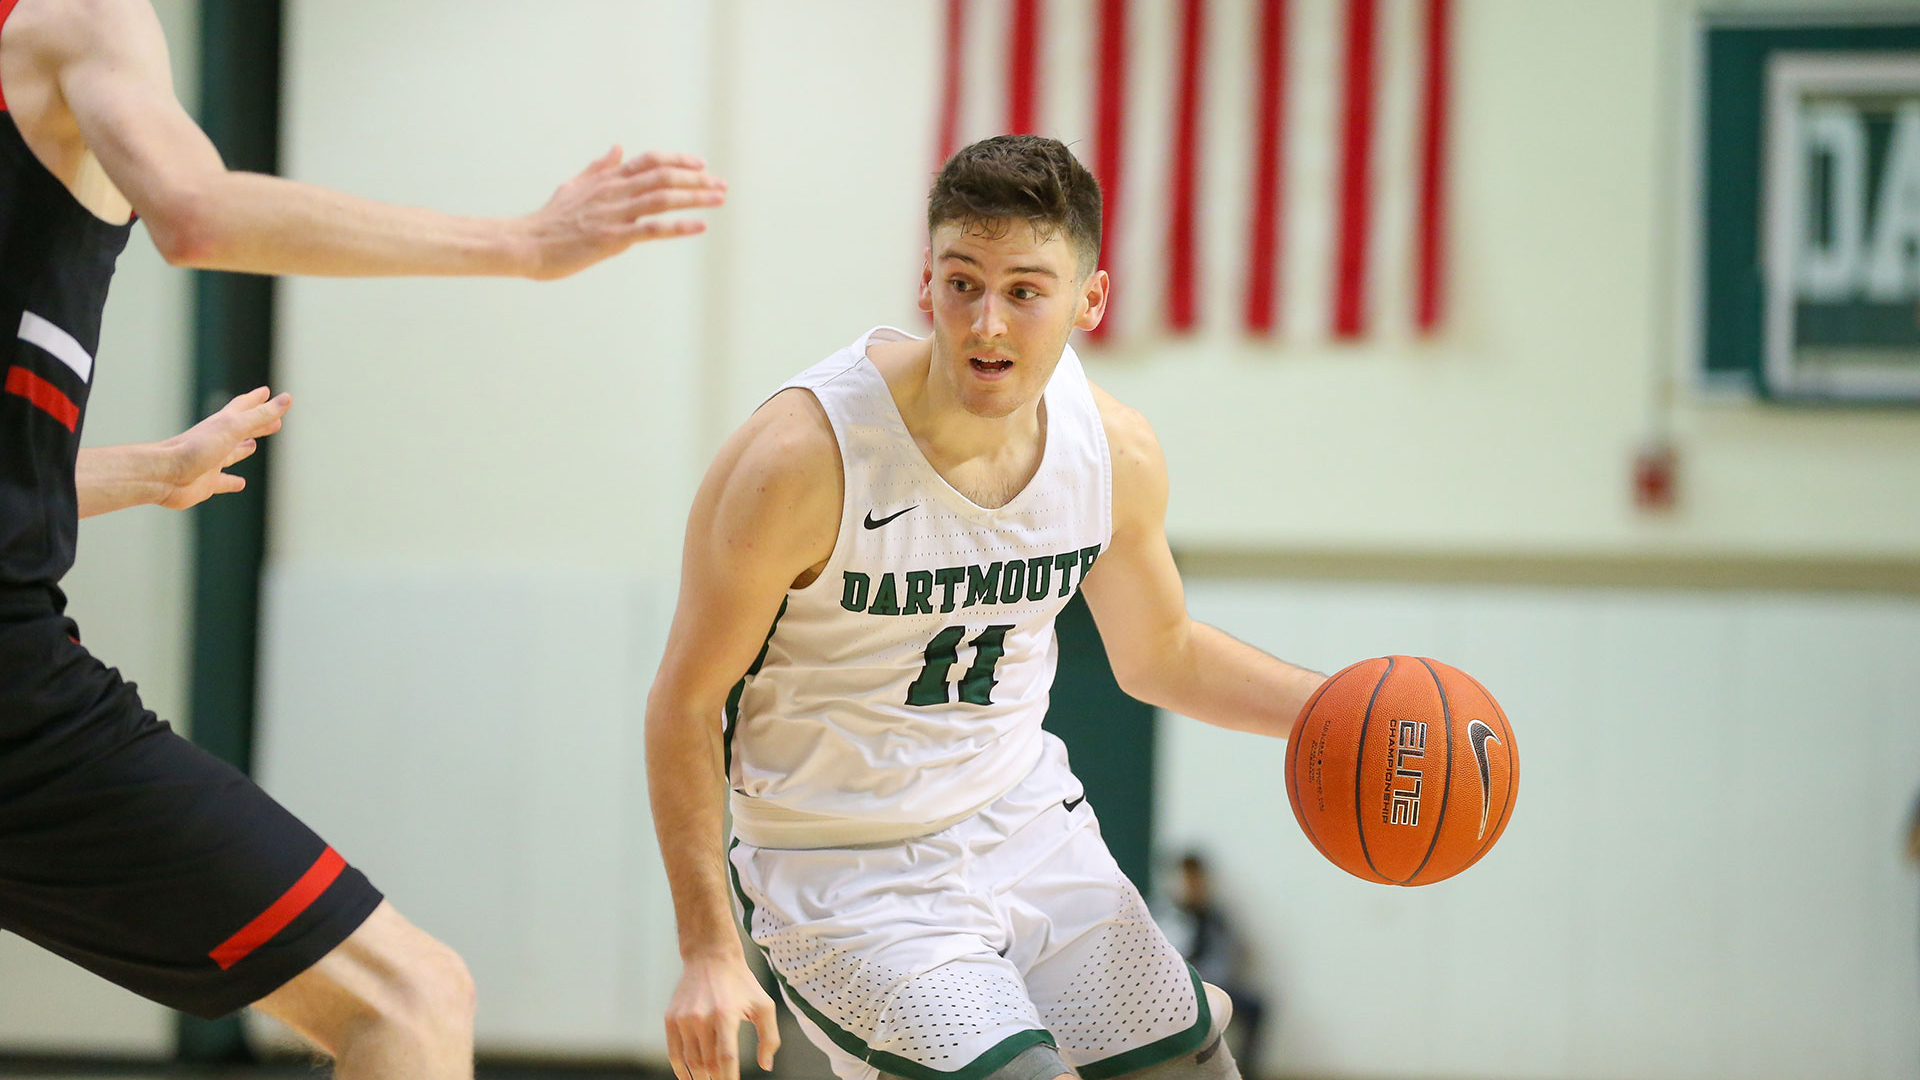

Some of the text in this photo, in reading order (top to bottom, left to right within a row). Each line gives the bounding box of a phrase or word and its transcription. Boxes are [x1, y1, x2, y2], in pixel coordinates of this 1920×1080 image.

[904, 624, 1016, 706] 11
[1381, 719, 1397, 824] CHAMPIONSHIP
[1390, 719, 1428, 827] ELITE
